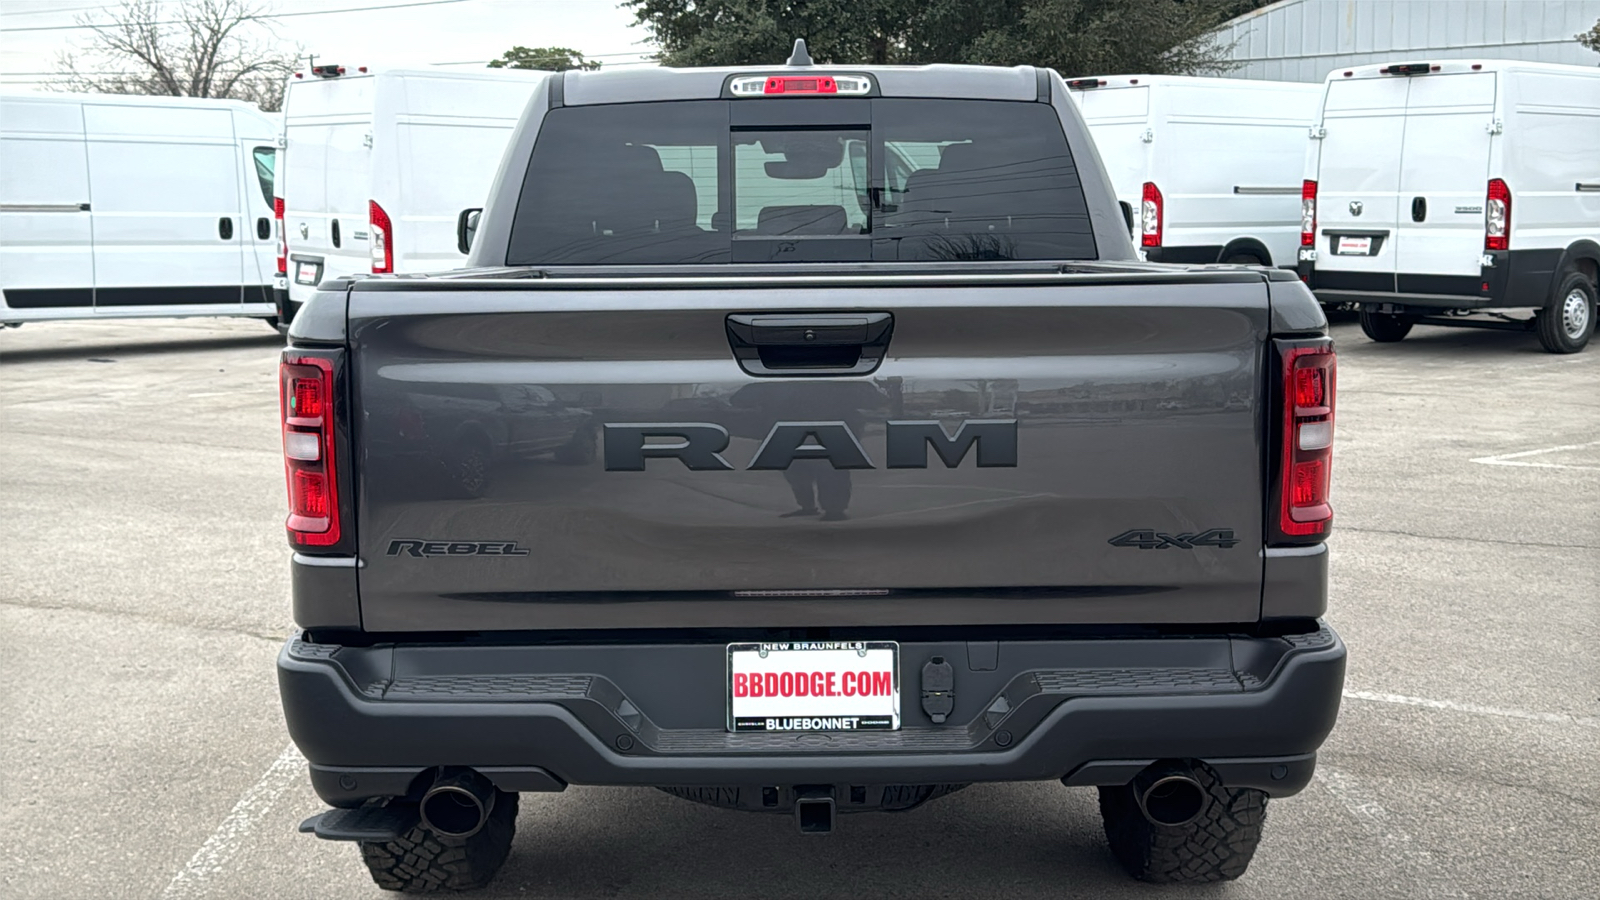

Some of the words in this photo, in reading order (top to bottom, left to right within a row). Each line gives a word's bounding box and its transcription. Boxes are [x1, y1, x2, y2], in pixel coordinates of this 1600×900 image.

[603, 419, 1018, 472] RAM
[386, 538, 531, 558] REBEL
[1108, 528, 1241, 550] 4x4
[793, 642, 863, 650] BRAUNFELS
[734, 672, 892, 697] BBDODGE.COM
[766, 718, 859, 730] BLUEBONNET
